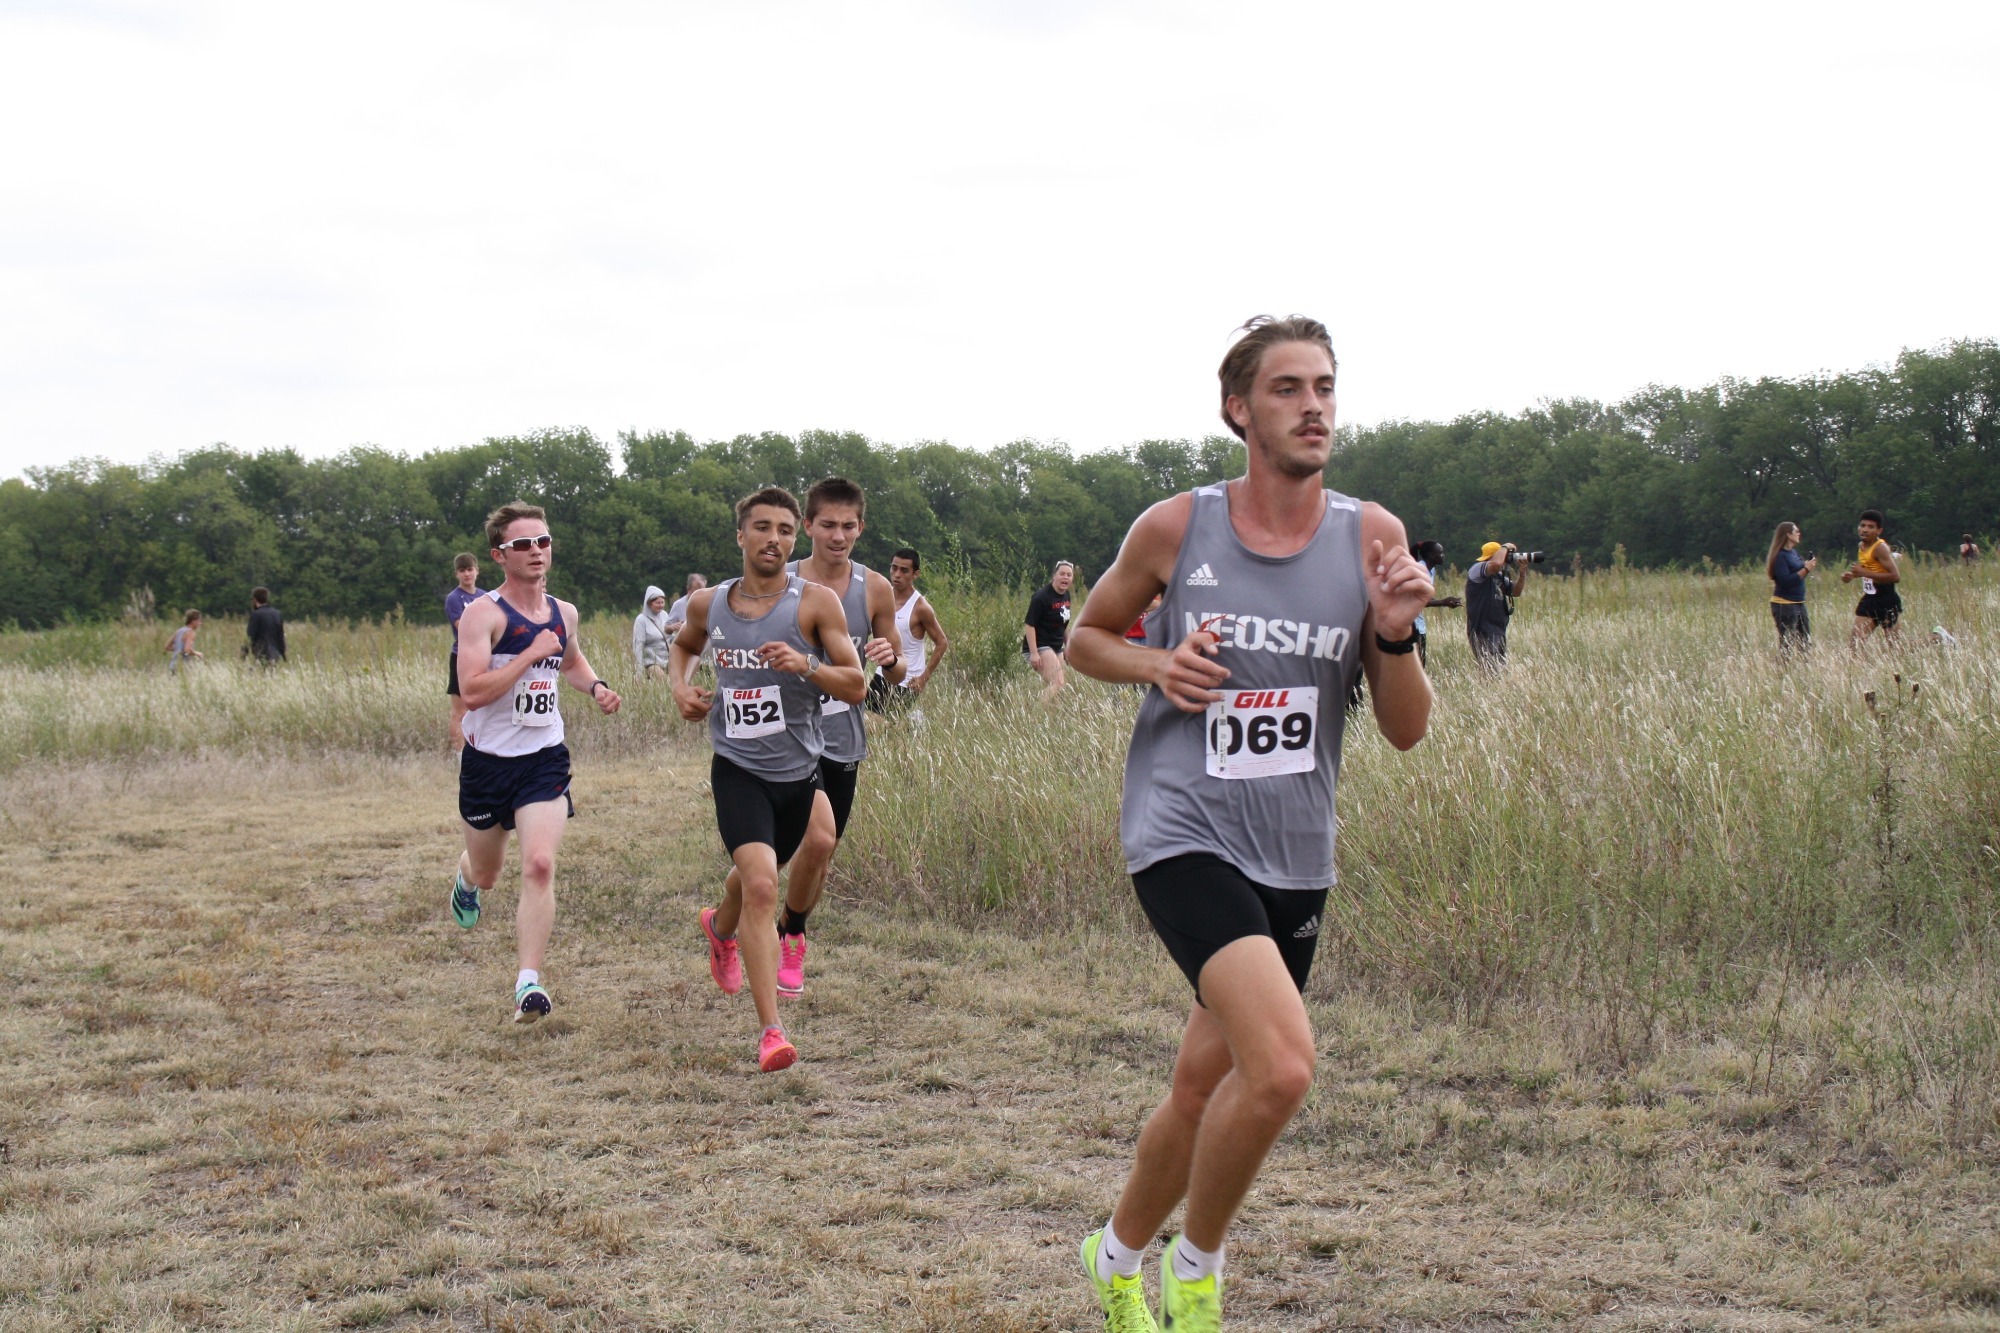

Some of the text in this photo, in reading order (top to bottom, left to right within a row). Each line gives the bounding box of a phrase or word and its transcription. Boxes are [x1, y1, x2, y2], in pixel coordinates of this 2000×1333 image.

[1186, 577, 1218, 586] adidas
[1185, 611, 1350, 662] NEOSHO
[712, 647, 776, 669] NEOS
[529, 681, 551, 690] GILL
[733, 689, 762, 700] GILL
[515, 692, 555, 714] 089
[1234, 690, 1290, 709] GILL
[726, 700, 780, 725] 052
[1210, 712, 1312, 756] 069
